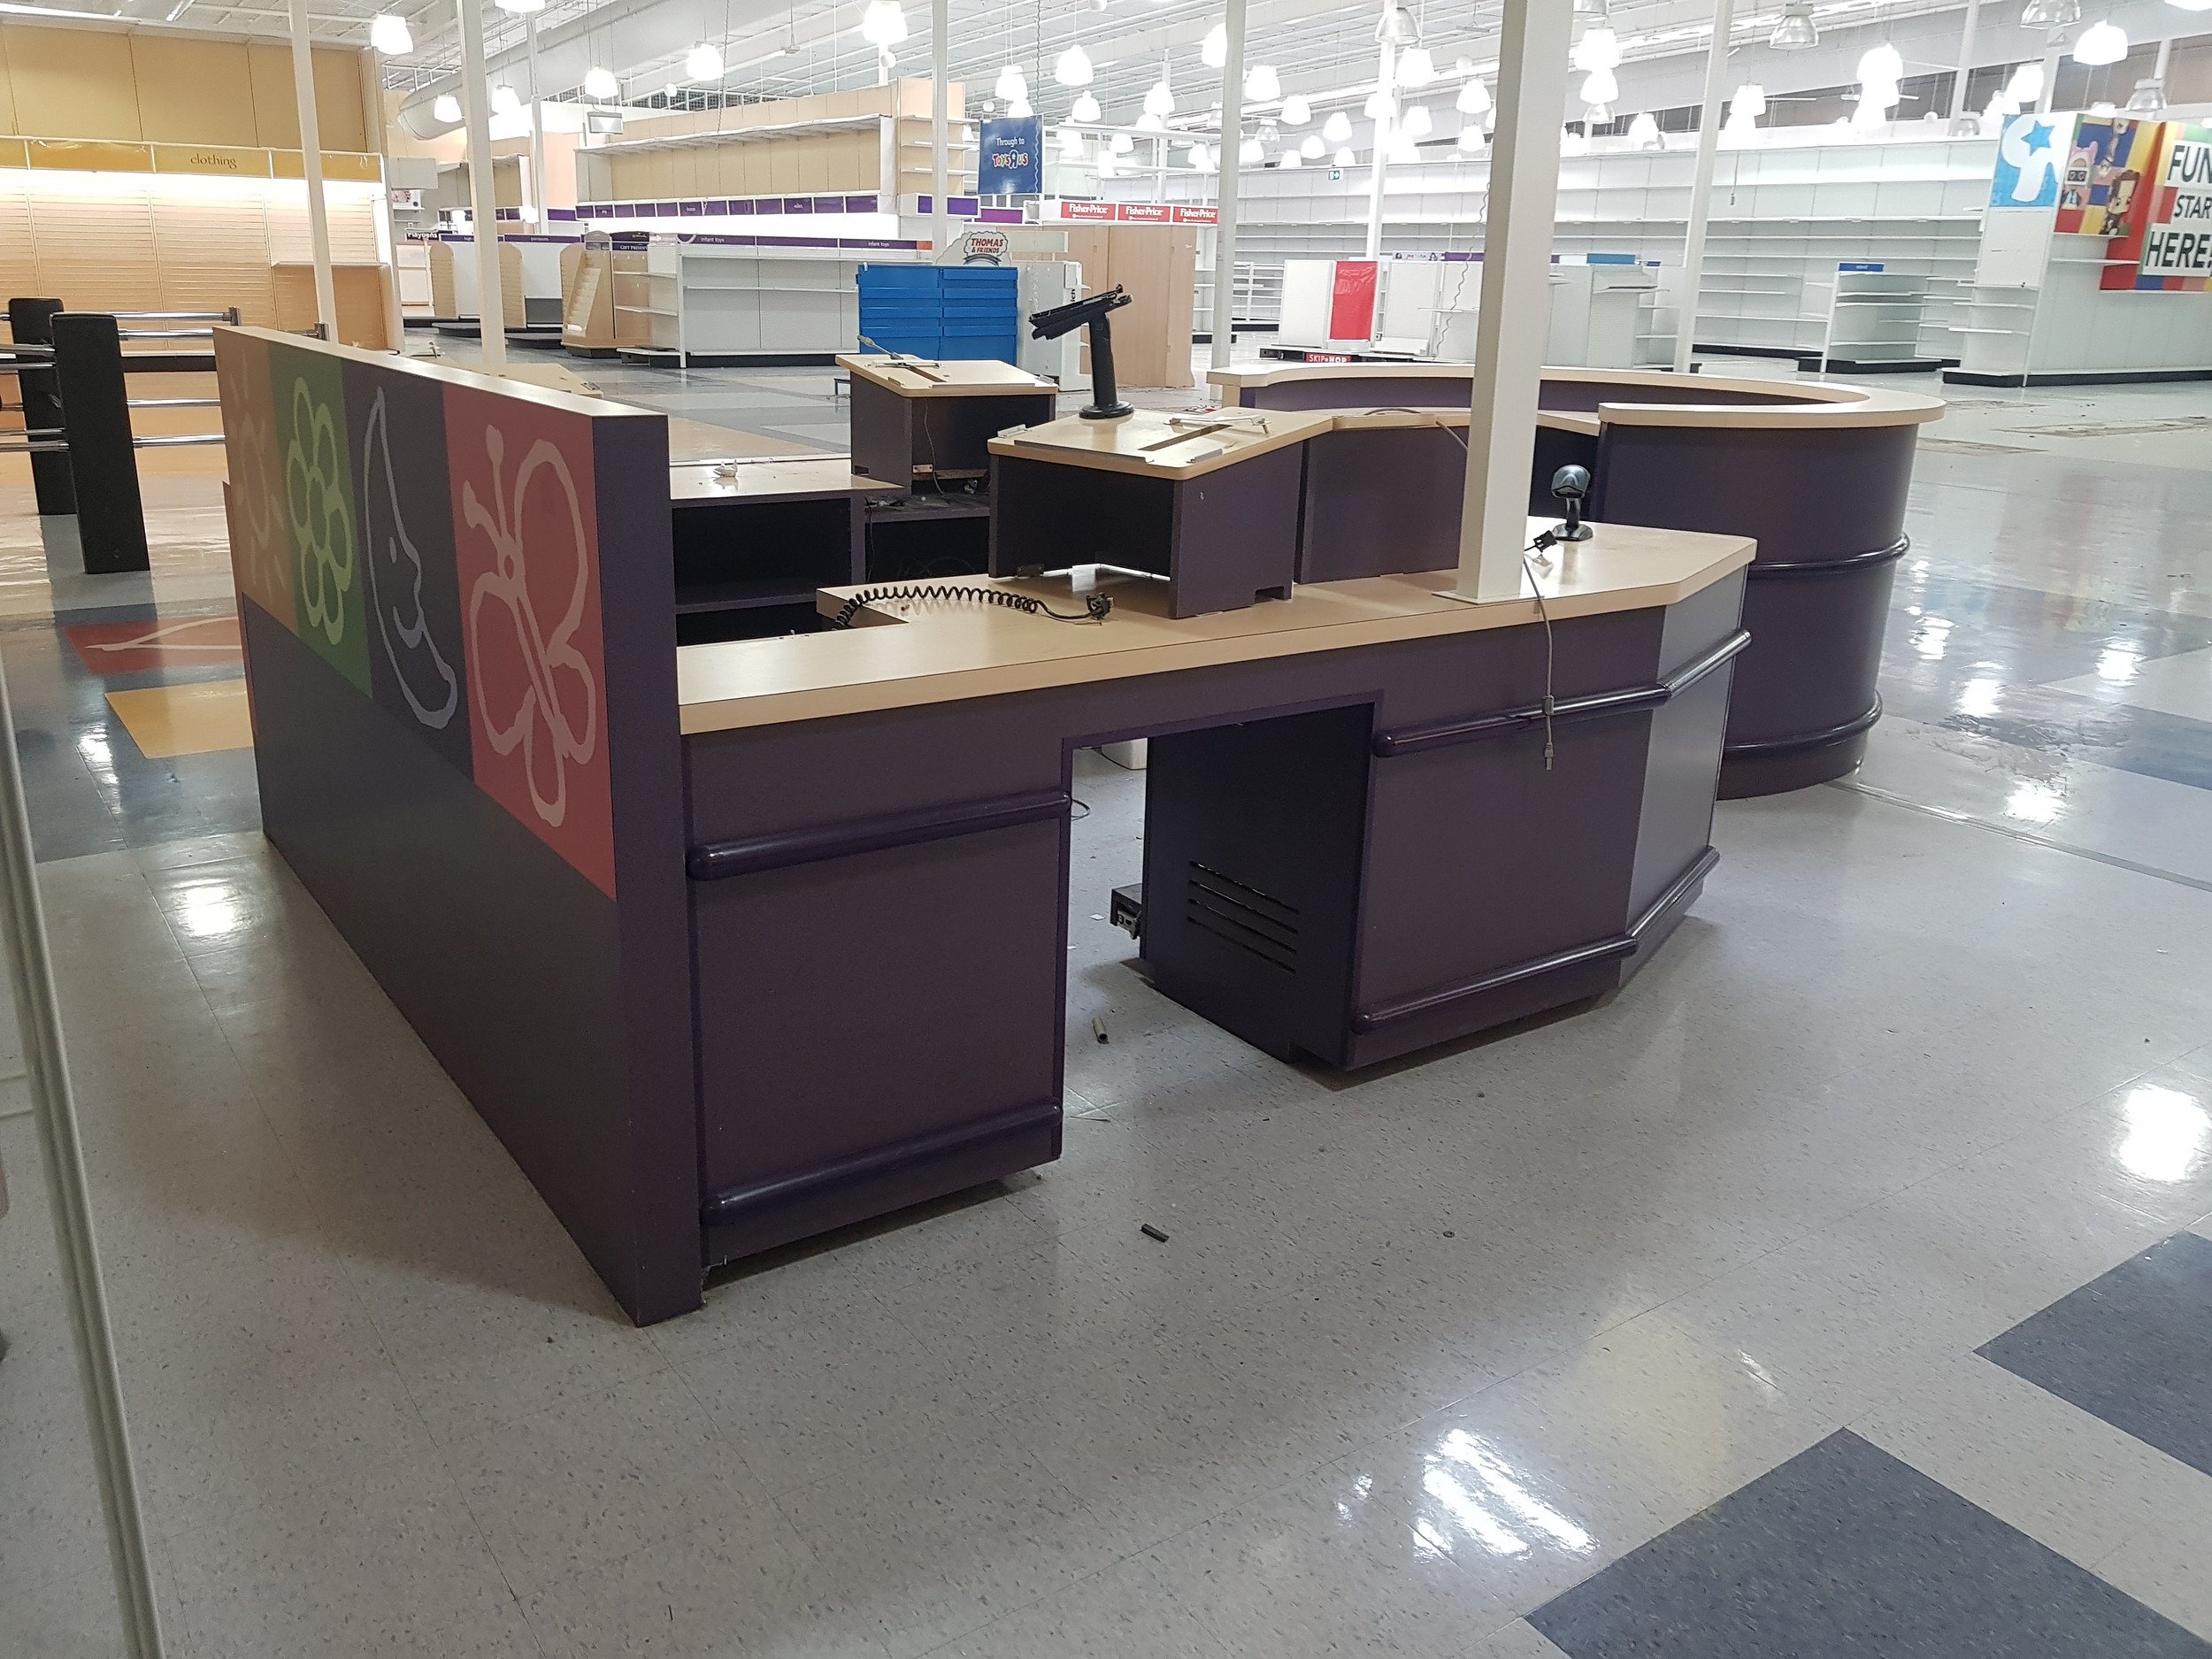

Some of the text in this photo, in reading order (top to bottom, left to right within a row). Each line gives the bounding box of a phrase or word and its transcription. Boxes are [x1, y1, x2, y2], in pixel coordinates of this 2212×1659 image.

[996, 136, 1025, 148] Through to
[190, 153, 237, 169] clothing
[2167, 144, 2212, 183] FUN
[1069, 203, 1109, 214] Fisher-Price
[1125, 205, 1164, 216] Fisher-Price
[1179, 208, 1217, 218] Fisher-Price
[971, 238, 1004, 247] THOMAS
[2145, 231, 2212, 268] HERE
[1309, 354, 1325, 363] SKIP
